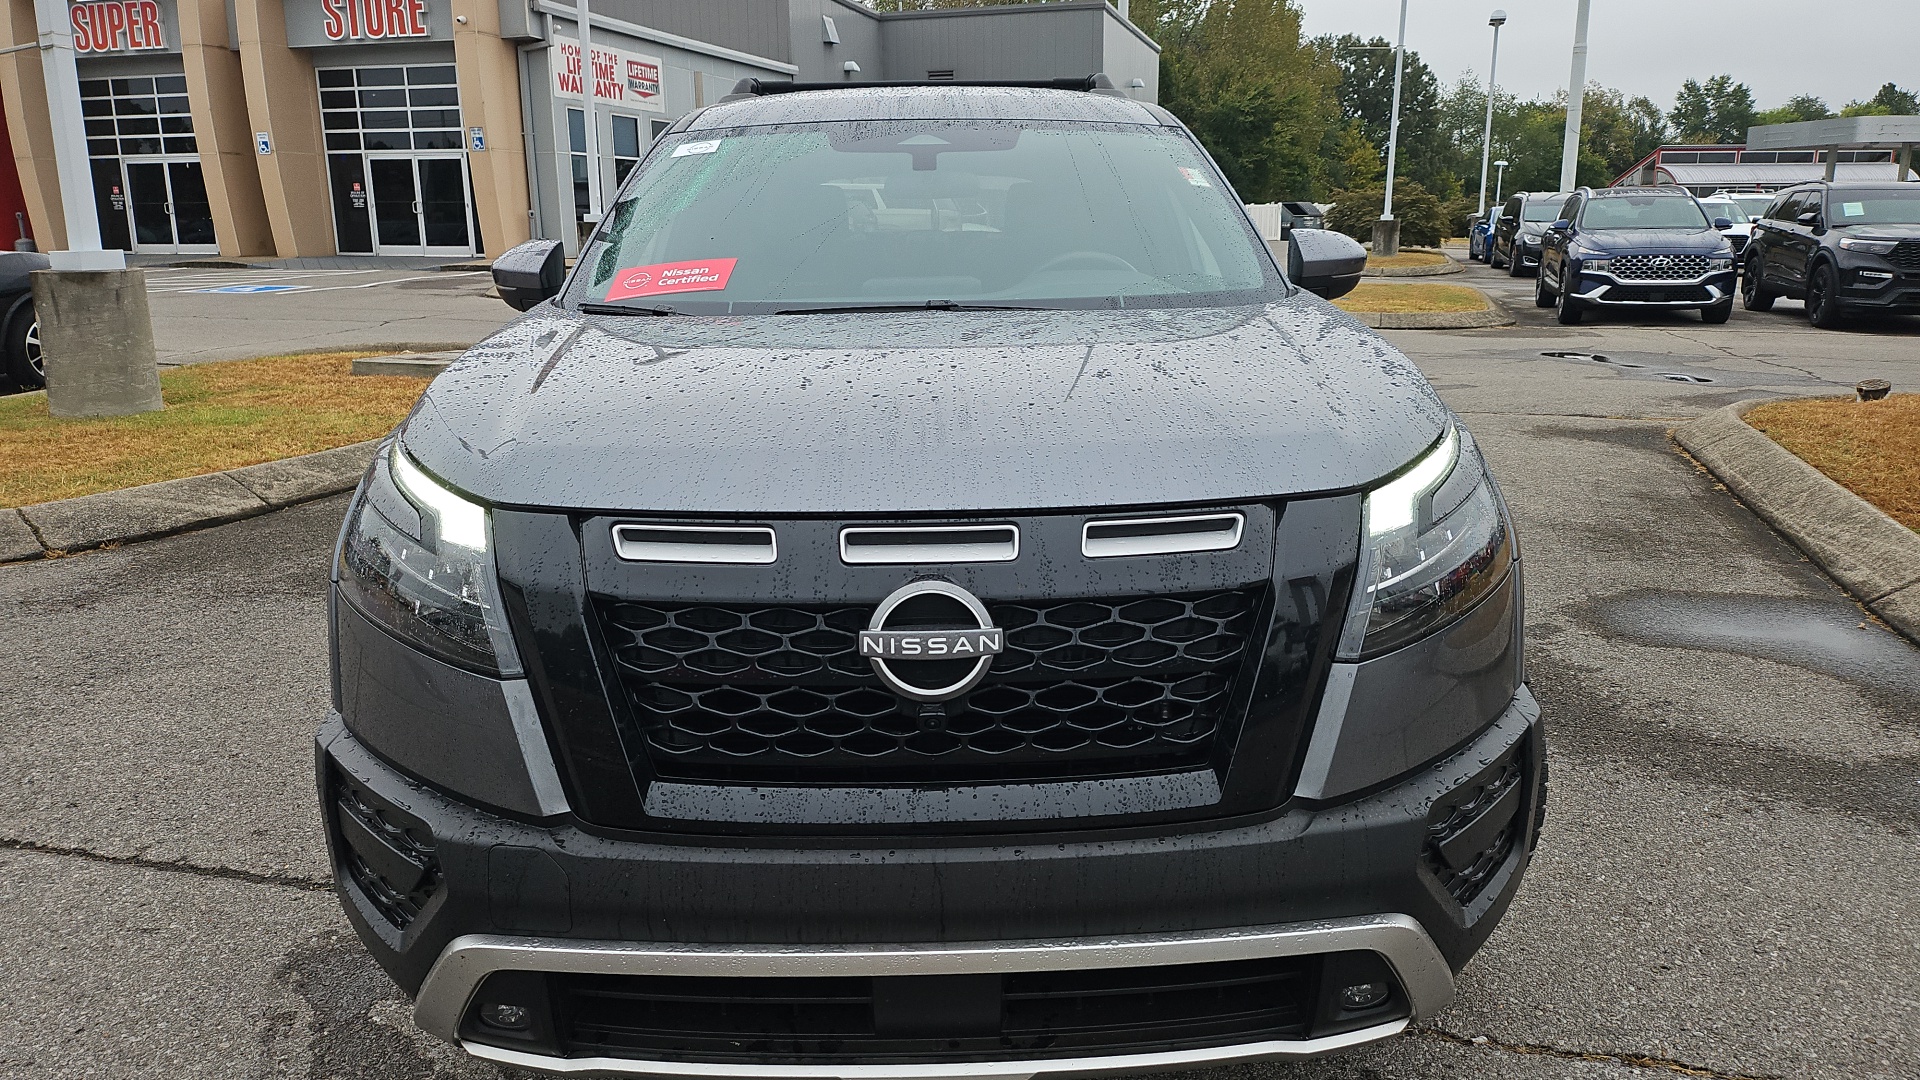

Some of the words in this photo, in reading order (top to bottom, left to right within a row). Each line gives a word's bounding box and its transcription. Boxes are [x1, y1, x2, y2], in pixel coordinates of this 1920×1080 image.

[71, 1, 164, 52] SUPER
[561, 43, 581, 57] HOM
[591, 50, 600, 61] OF
[604, 53, 618, 65] THE
[628, 63, 658, 81] LIFETIME
[557, 73, 624, 100] WAANTY
[628, 78, 659, 94] WARRANTY
[658, 274, 719, 286] Certified
[661, 268, 709, 277] Nissan
[863, 634, 999, 655] NISSAN
